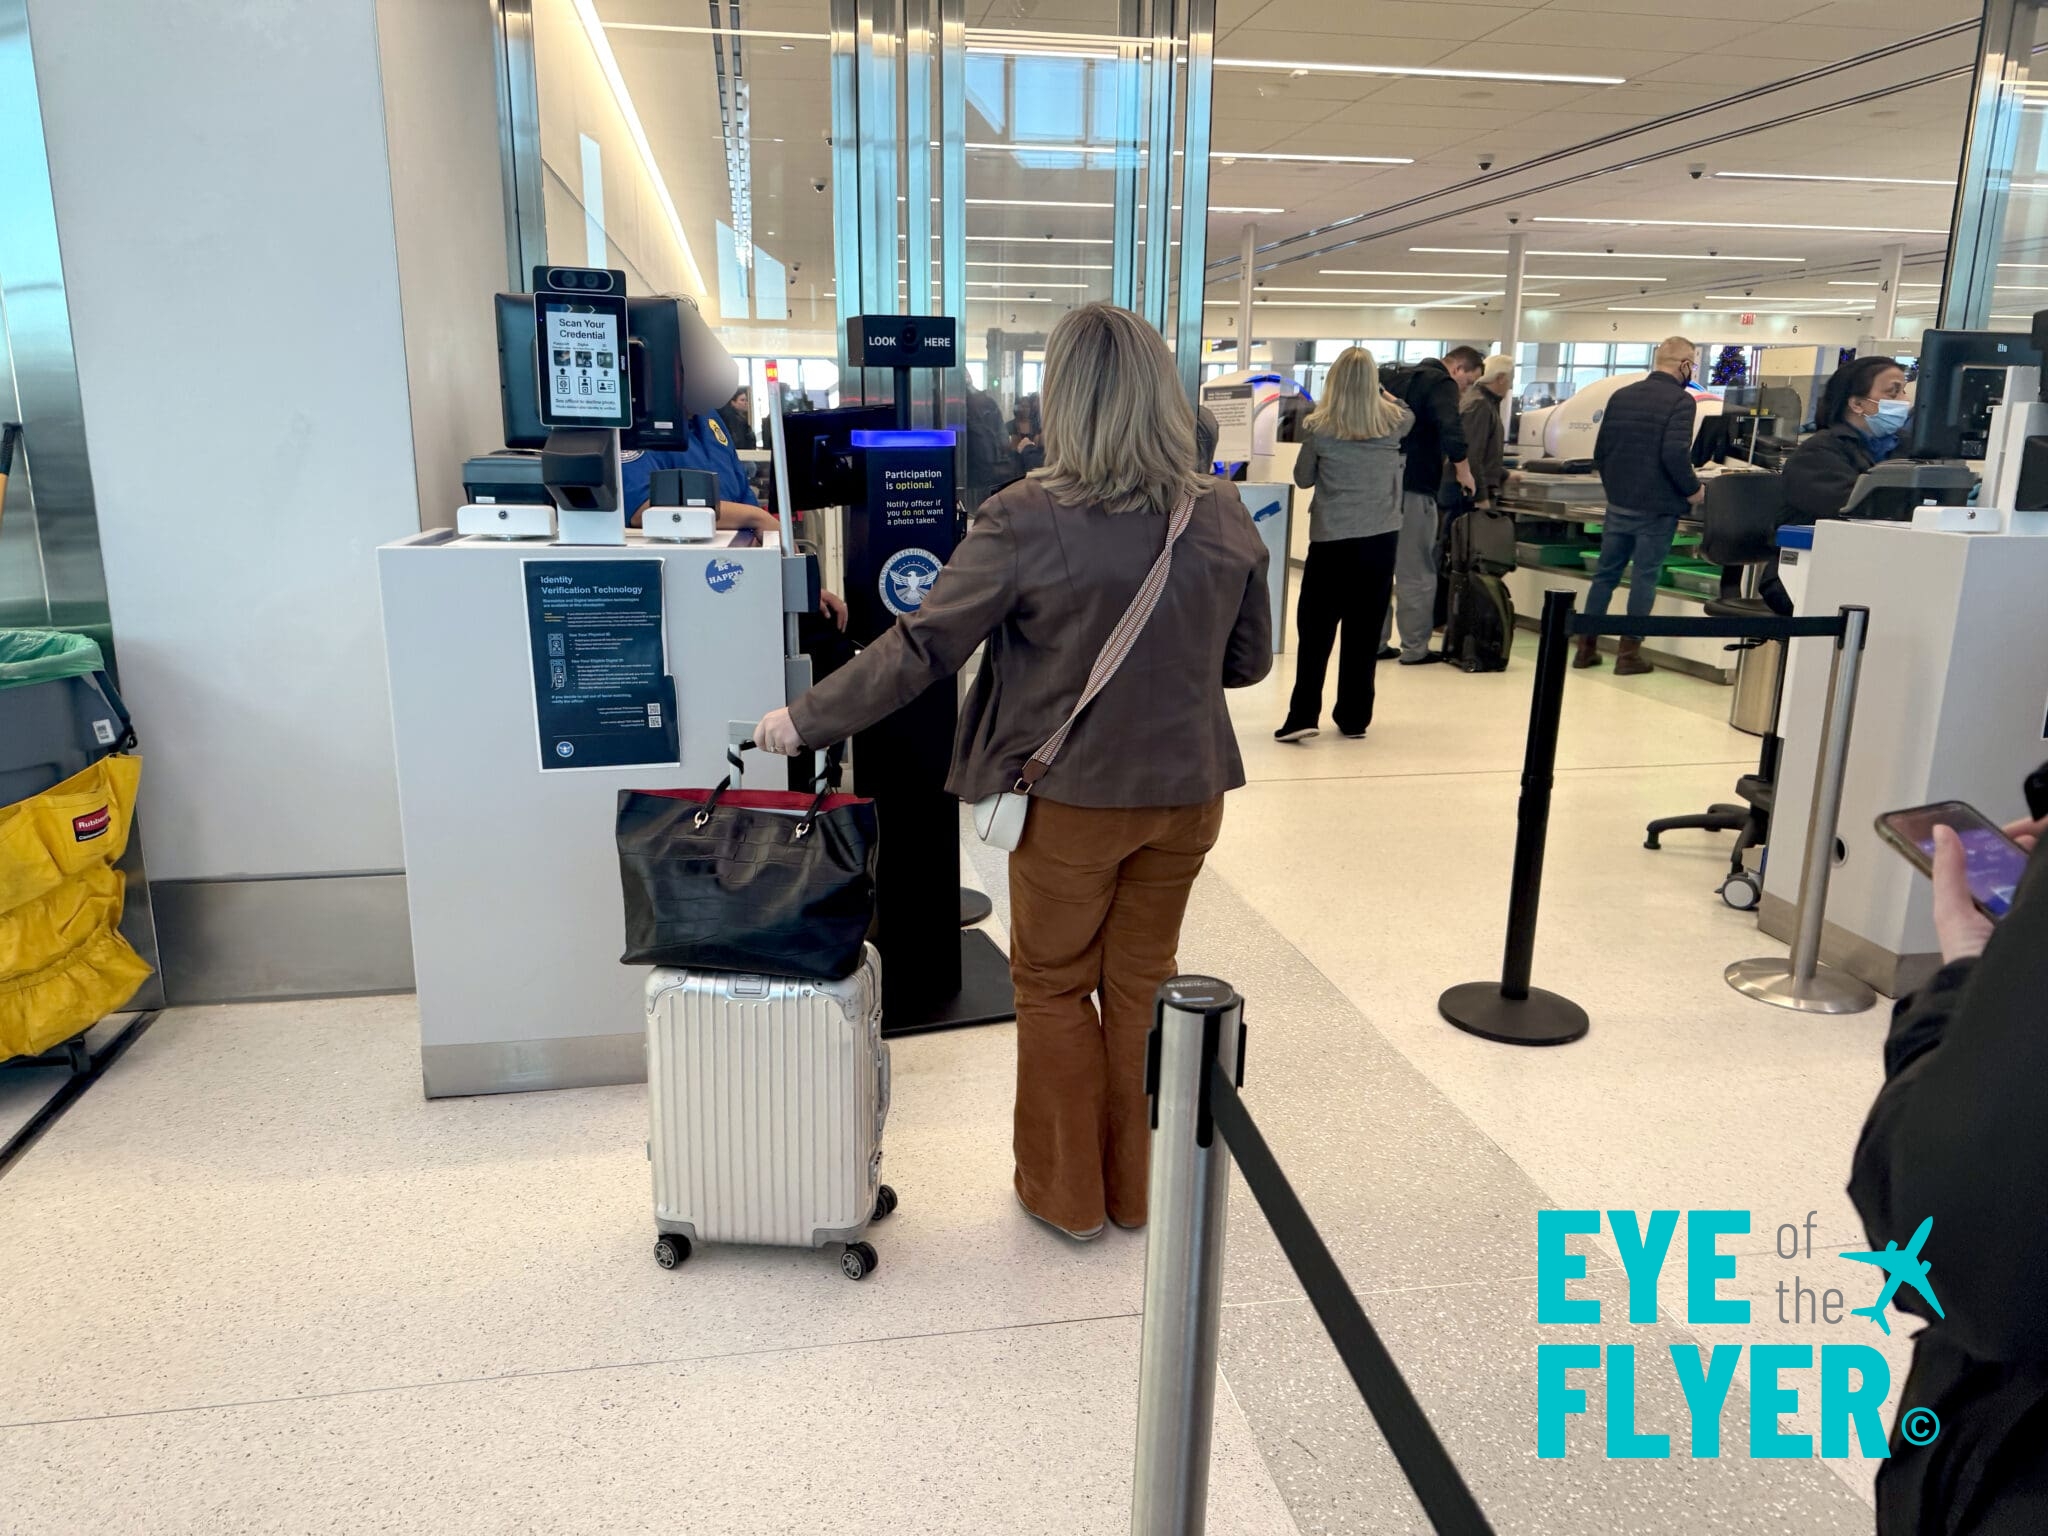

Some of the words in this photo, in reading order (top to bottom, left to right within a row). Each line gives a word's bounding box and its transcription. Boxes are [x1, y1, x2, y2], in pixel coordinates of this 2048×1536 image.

[1010, 314, 1017, 323] 2
[1228, 317, 1234, 326] 3
[559, 318, 582, 328] Scan
[583, 319, 605, 329] Your
[1612, 322, 1618, 331] 5
[1792, 325, 1798, 334] 6
[559, 329, 606, 340] Credential
[868, 336, 897, 346] LOOK
[924, 337, 951, 347] HERE
[885, 469, 942, 479] Participation
[885, 481, 894, 490] is
[895, 480, 935, 491] optional.
[886, 500, 909, 508] Notify
[910, 499, 934, 507] officer
[935, 499, 941, 507] if
[913, 508, 925, 516] not
[893, 518, 914, 526] photo
[915, 517, 938, 525] taken.
[540, 576, 573, 585] Identity
[541, 586, 591, 595] Verification
[592, 585, 643, 595] Technology
